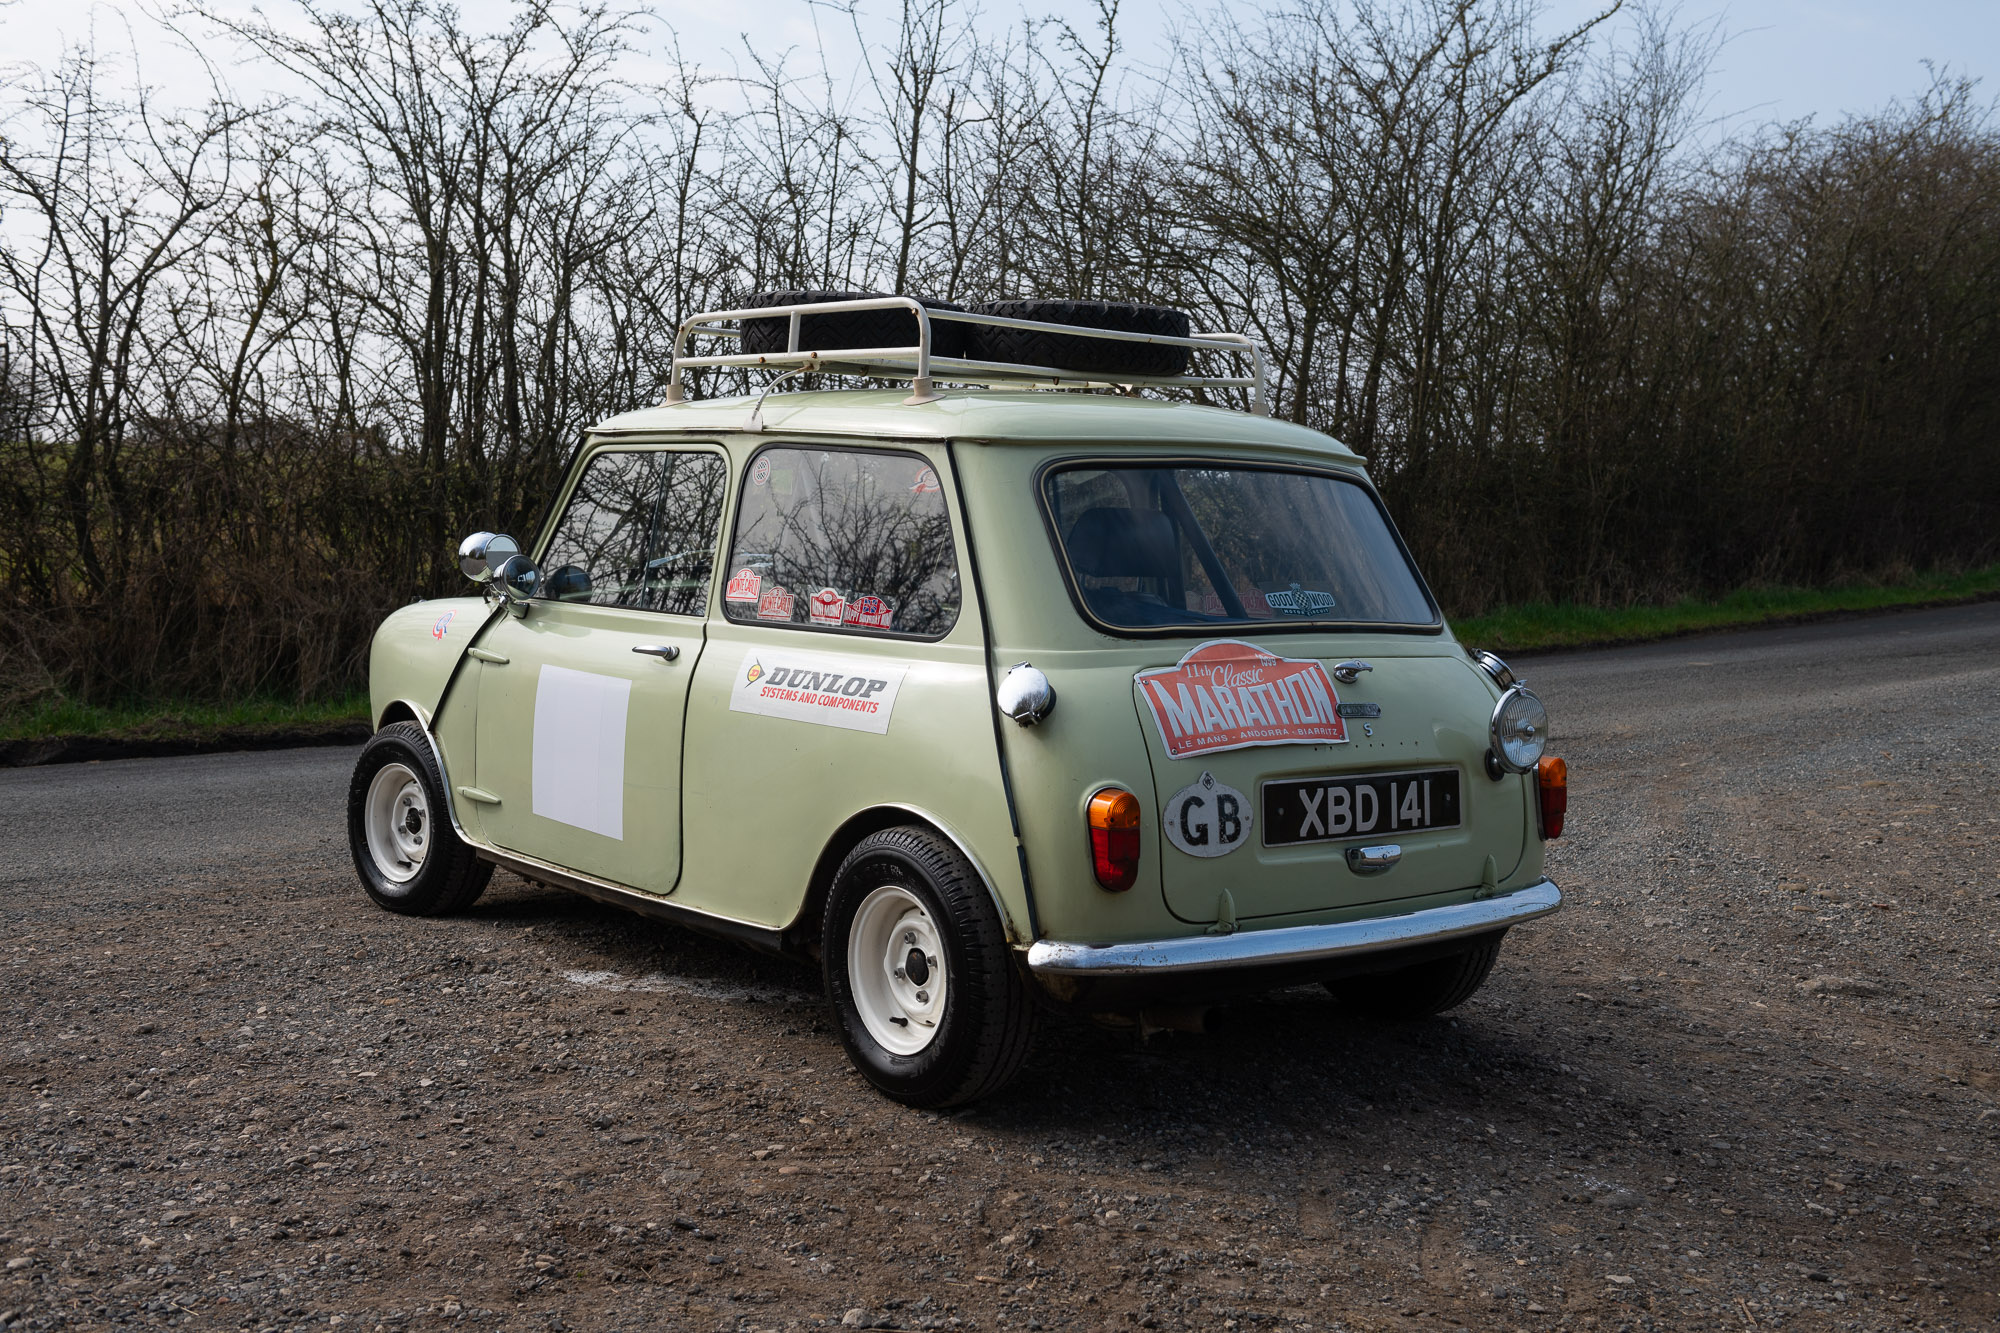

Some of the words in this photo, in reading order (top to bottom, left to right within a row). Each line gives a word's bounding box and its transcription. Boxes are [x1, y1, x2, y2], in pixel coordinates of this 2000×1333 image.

[1267, 593, 1293, 607] GOOD
[1308, 593, 1334, 606] WOOD
[1307, 608, 1329, 616] CIRCUIT
[765, 666, 888, 699] DUNLOP
[1185, 664, 1211, 679] 11th
[1211, 663, 1265, 688] Classic
[760, 686, 798, 703] SYSTEMS
[798, 693, 817, 704] AND
[817, 694, 879, 714] COMPONENTS
[1150, 666, 1336, 738] MARATHON
[1178, 739, 1193, 749] LE
[1197, 734, 1228, 746] MANS
[1240, 728, 1289, 739] ANDORRA
[1297, 728, 1338, 736] BIARRITZ
[1363, 722, 1374, 737] S
[1180, 793, 1242, 847] GB
[1299, 783, 1379, 838] XBD
[1390, 779, 1431, 830] 141
